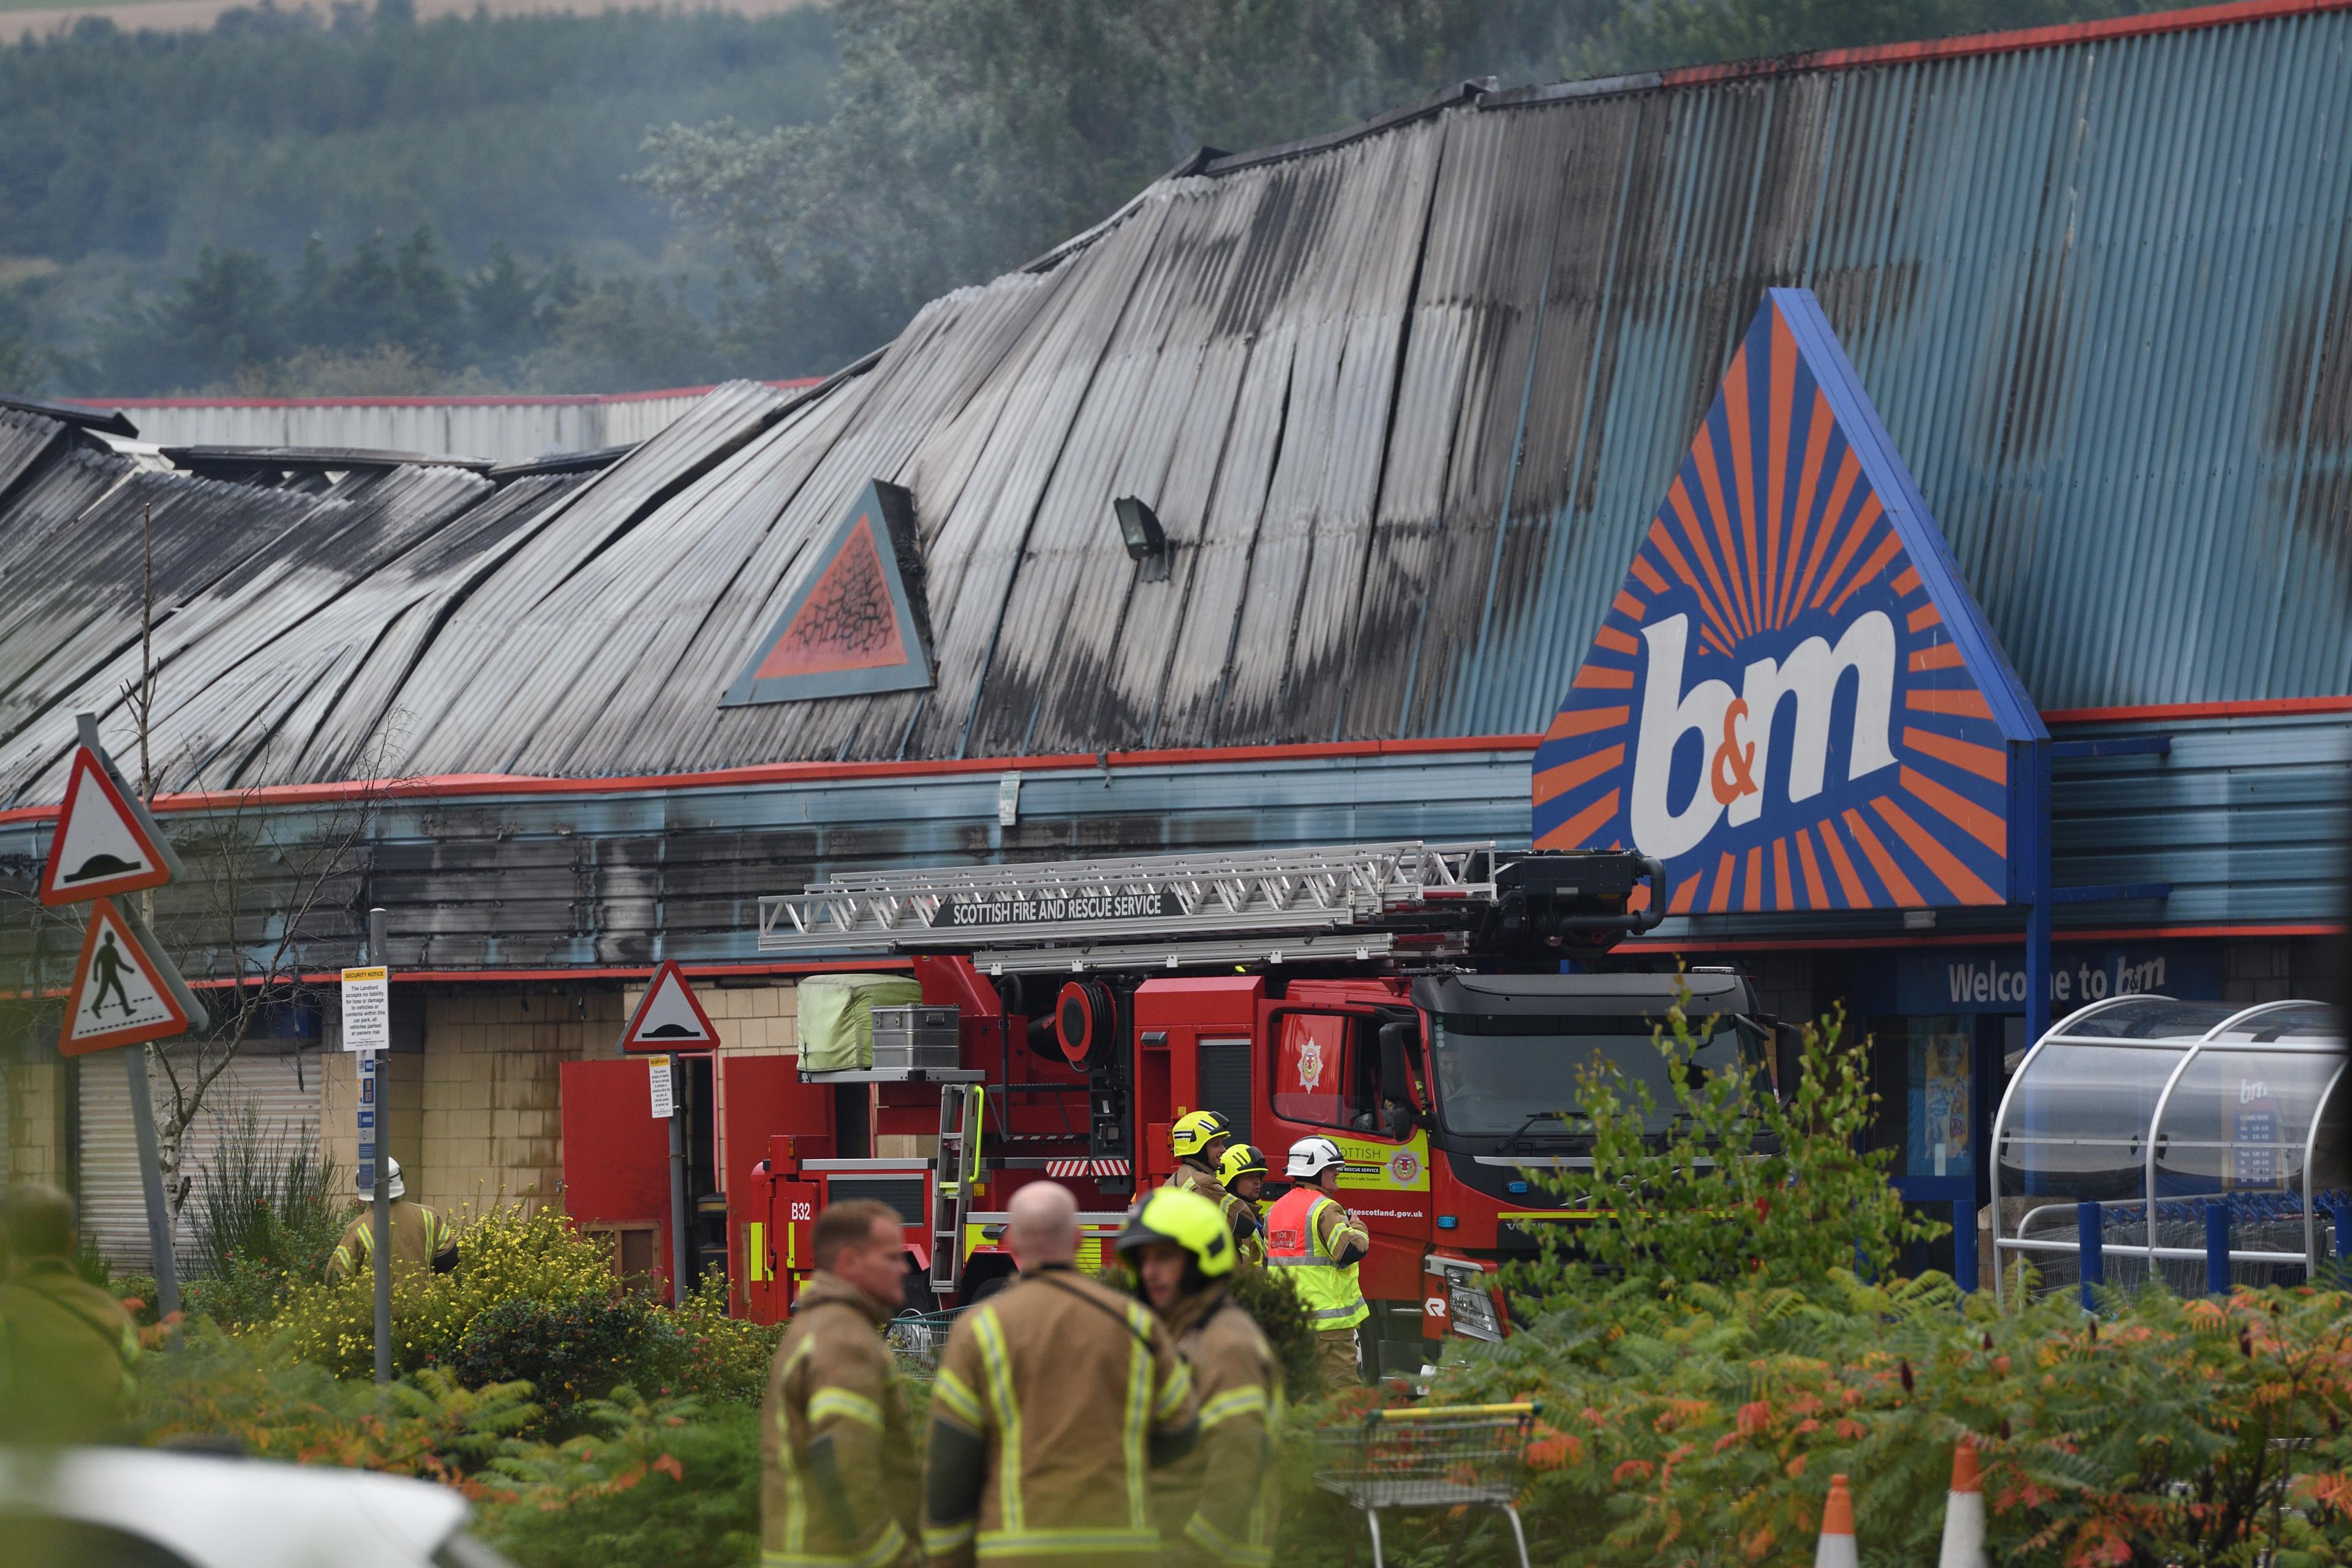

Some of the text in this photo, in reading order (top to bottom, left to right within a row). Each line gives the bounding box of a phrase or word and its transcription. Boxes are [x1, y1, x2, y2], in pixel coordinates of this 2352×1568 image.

[1630, 611, 1899, 860] b&m
[953, 894, 1161, 924] SCOTTISH FIRE AND RESCUE SERVICE
[1949, 956, 2165, 1002] Welcoe to b&m
[1340, 1147, 1381, 1159] OTTISH
[791, 1202, 810, 1220] B32
